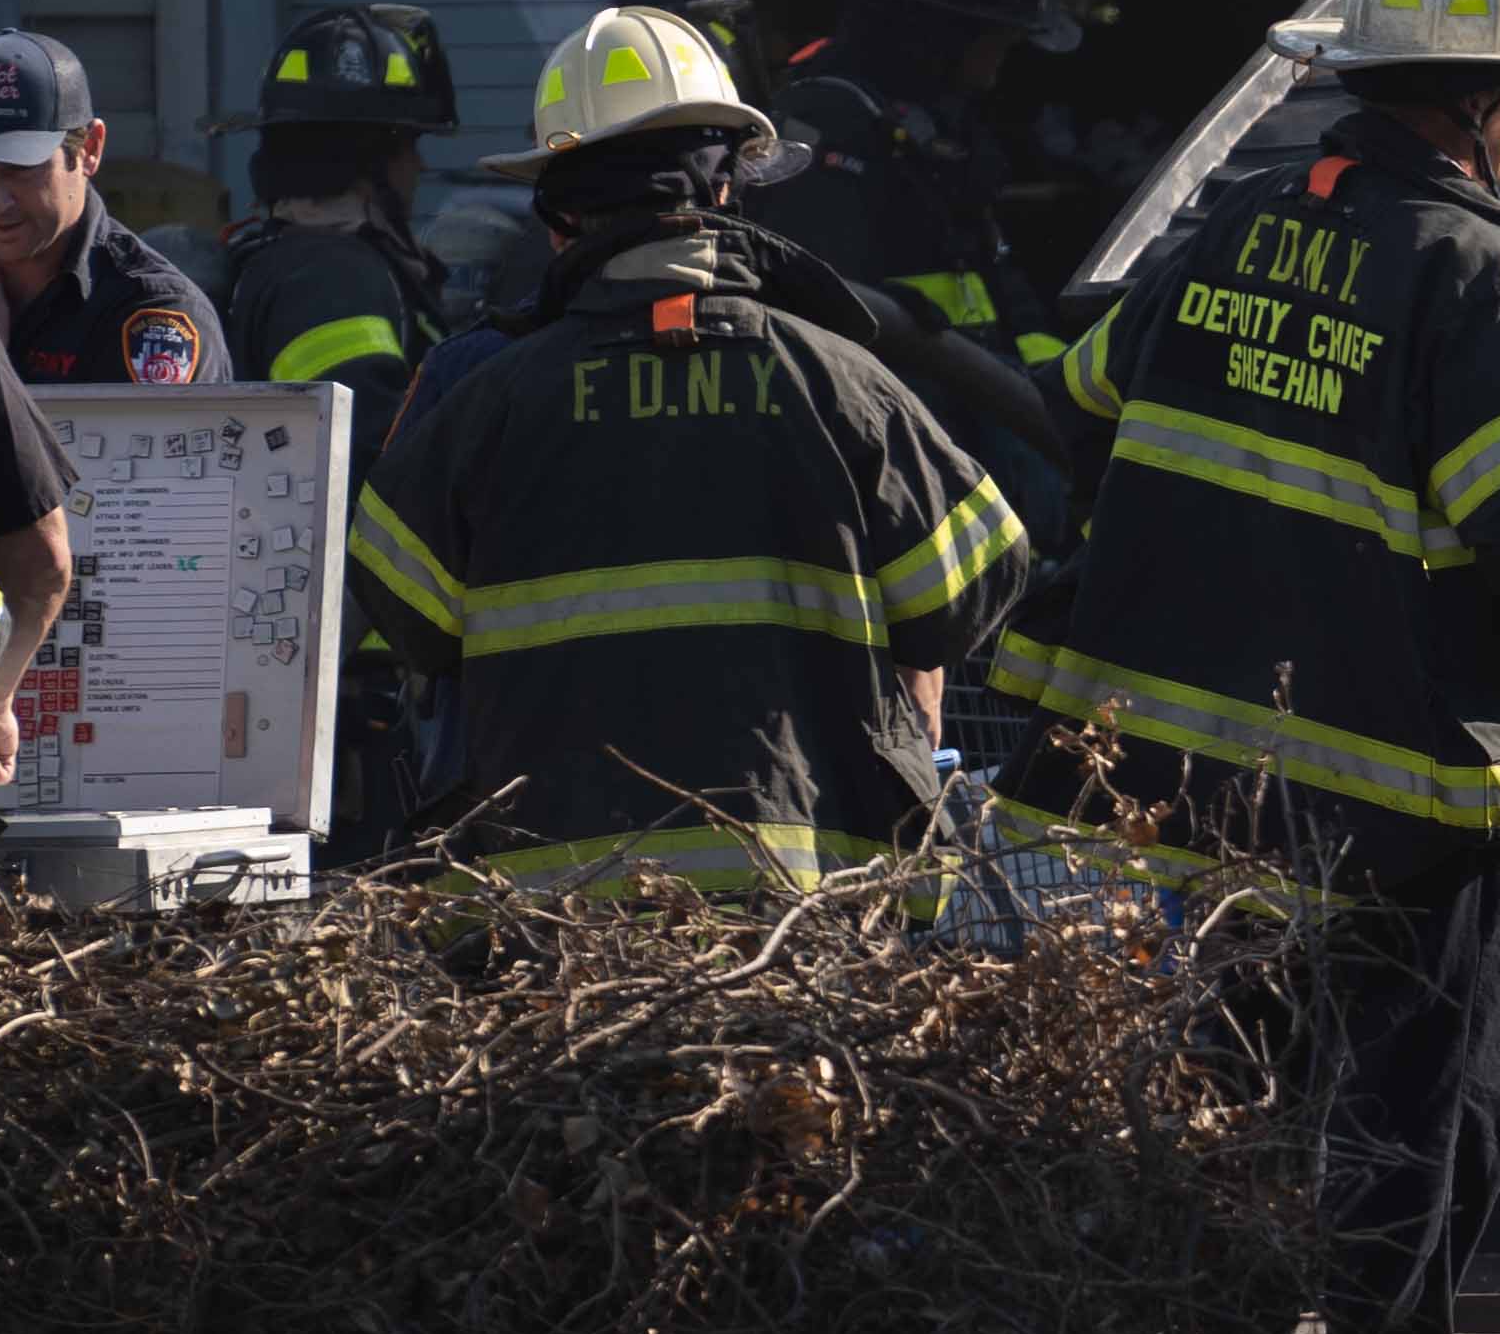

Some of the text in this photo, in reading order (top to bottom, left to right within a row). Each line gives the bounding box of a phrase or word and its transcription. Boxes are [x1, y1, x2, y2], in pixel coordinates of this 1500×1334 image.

[1177, 280, 1384, 376] DEPUTY CHIEF
[573, 350, 782, 423] F.D.N.Y.
[1226, 342, 1344, 415] SHEEHAN
